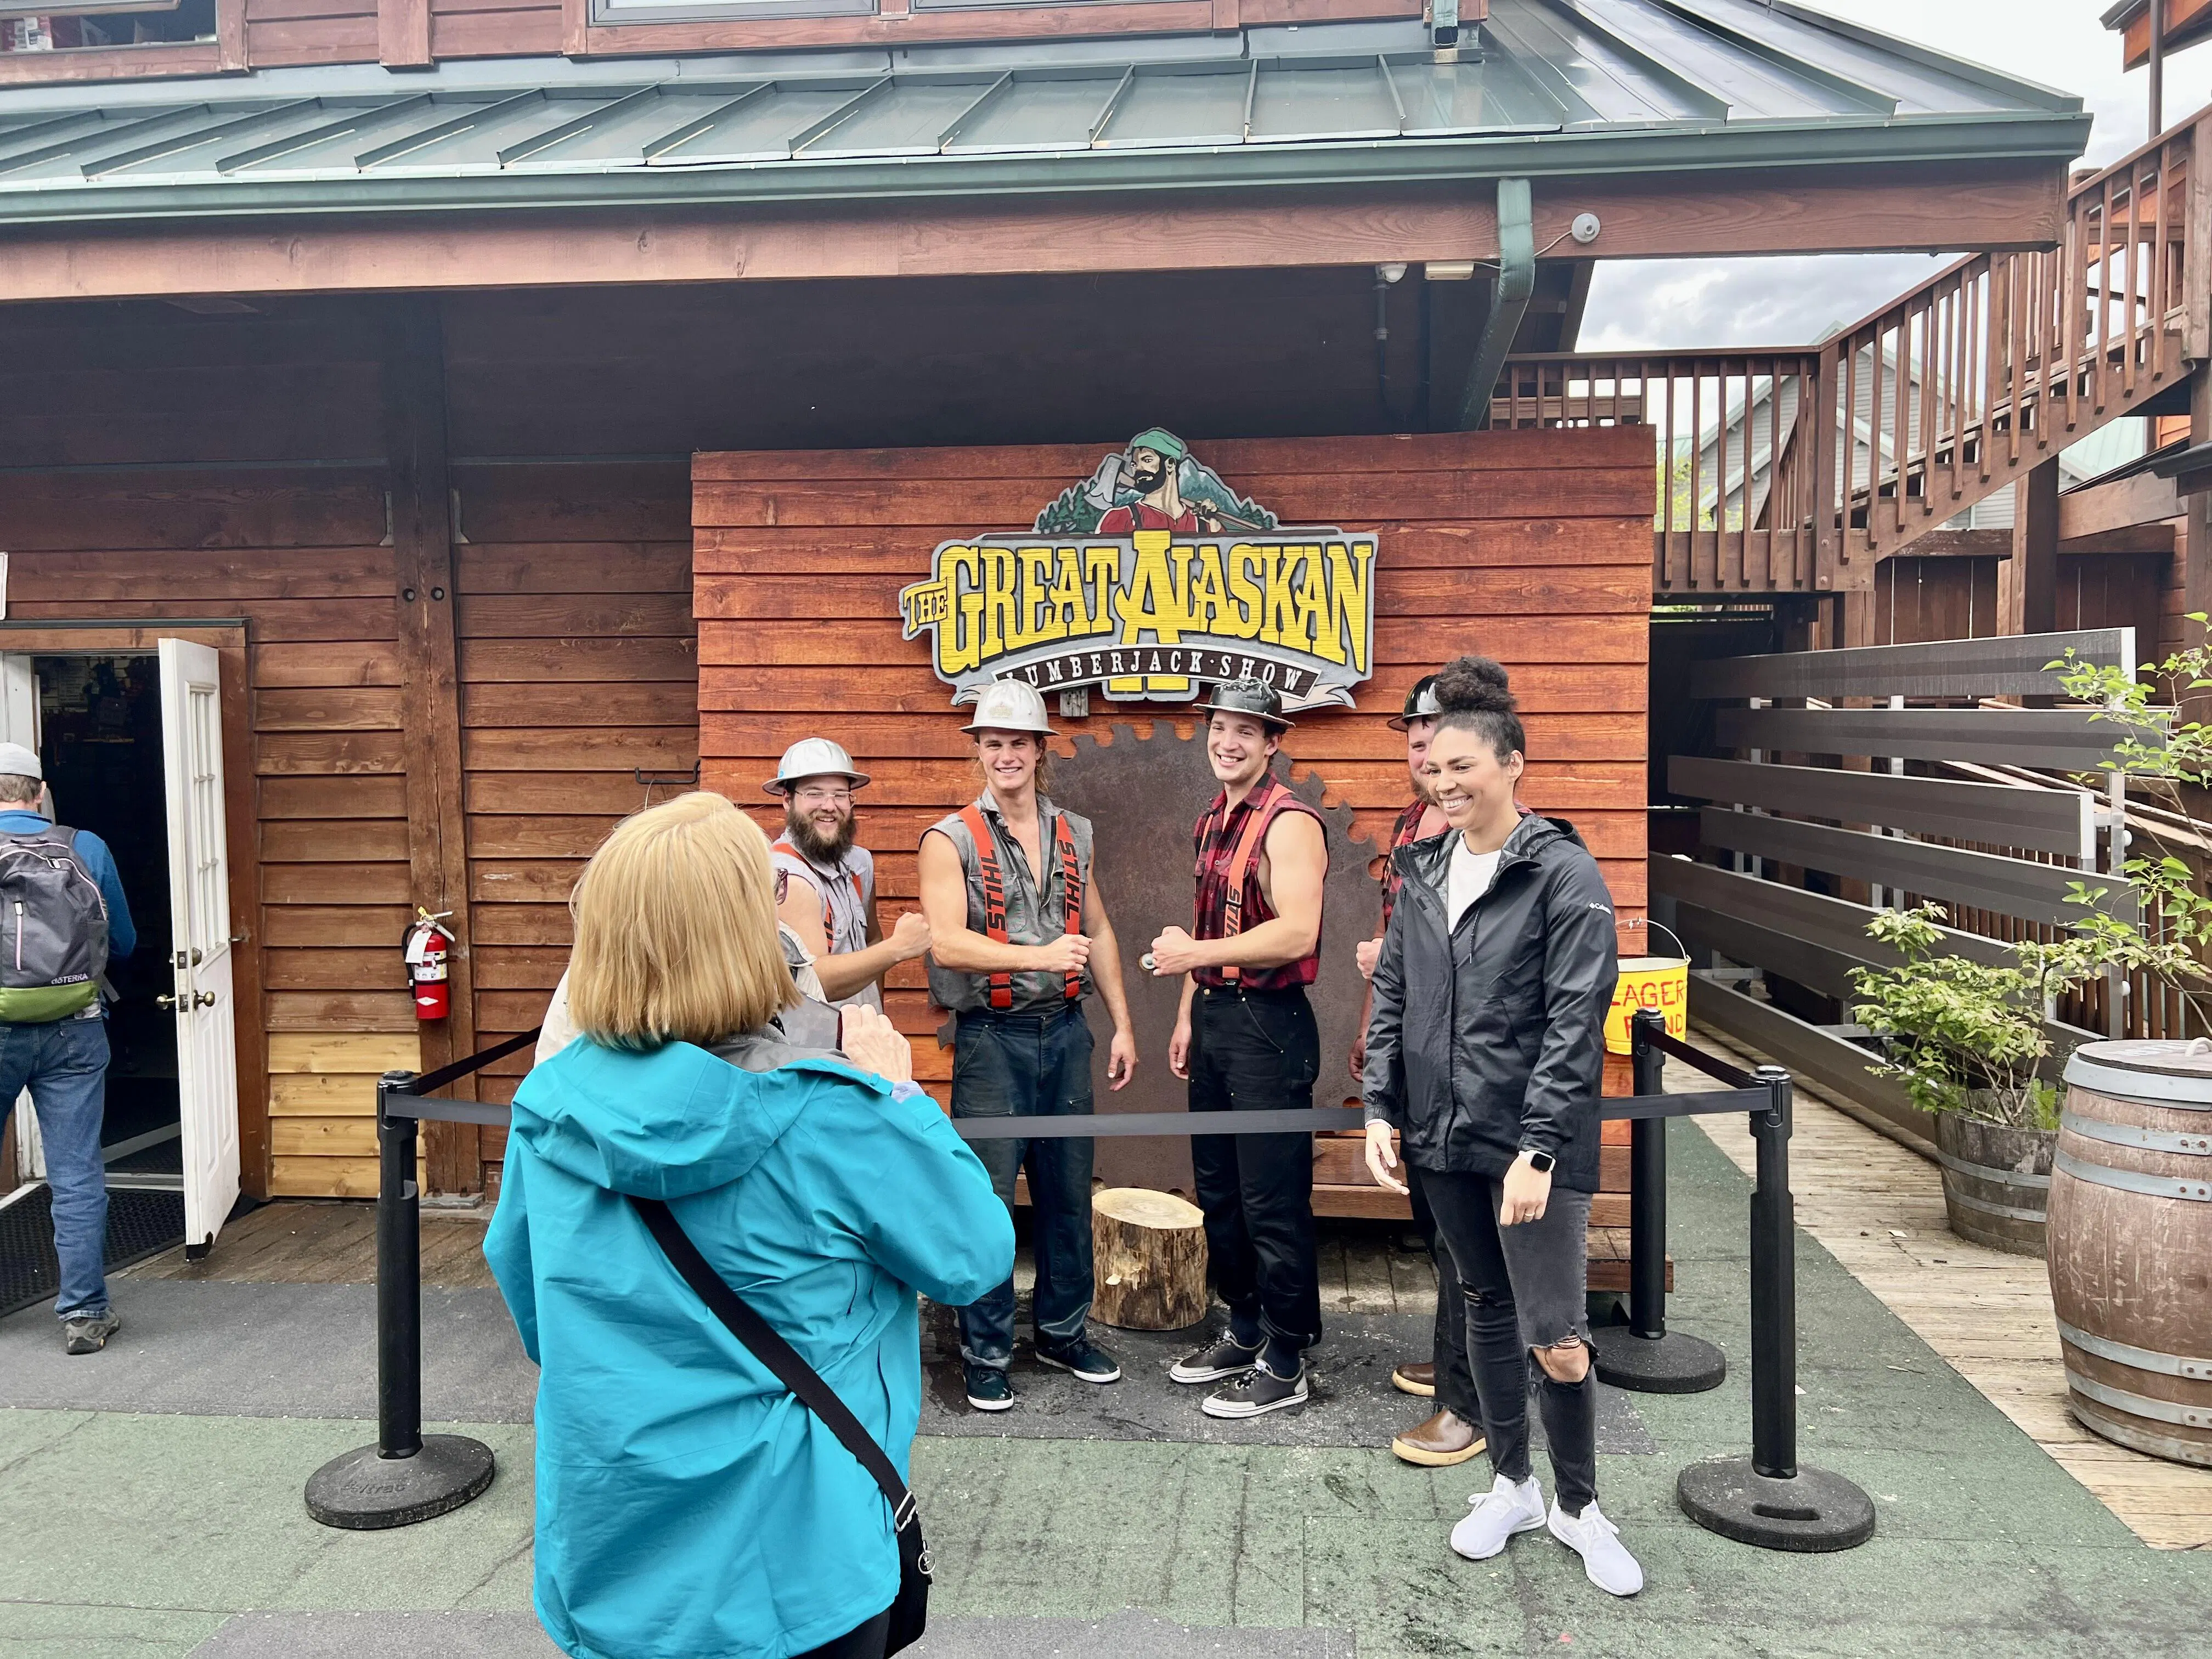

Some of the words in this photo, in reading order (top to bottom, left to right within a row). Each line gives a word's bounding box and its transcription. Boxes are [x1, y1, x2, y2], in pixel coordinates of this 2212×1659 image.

[904, 576, 947, 634] THE
[939, 545, 1119, 674] GREAT
[1109, 529, 1373, 691] ALASKAN
[1220, 655, 1302, 691] SHOW
[981, 849, 1006, 931] STIHL
[1057, 839, 1079, 920] STIHL
[1623, 1014, 1683, 1039] FND
